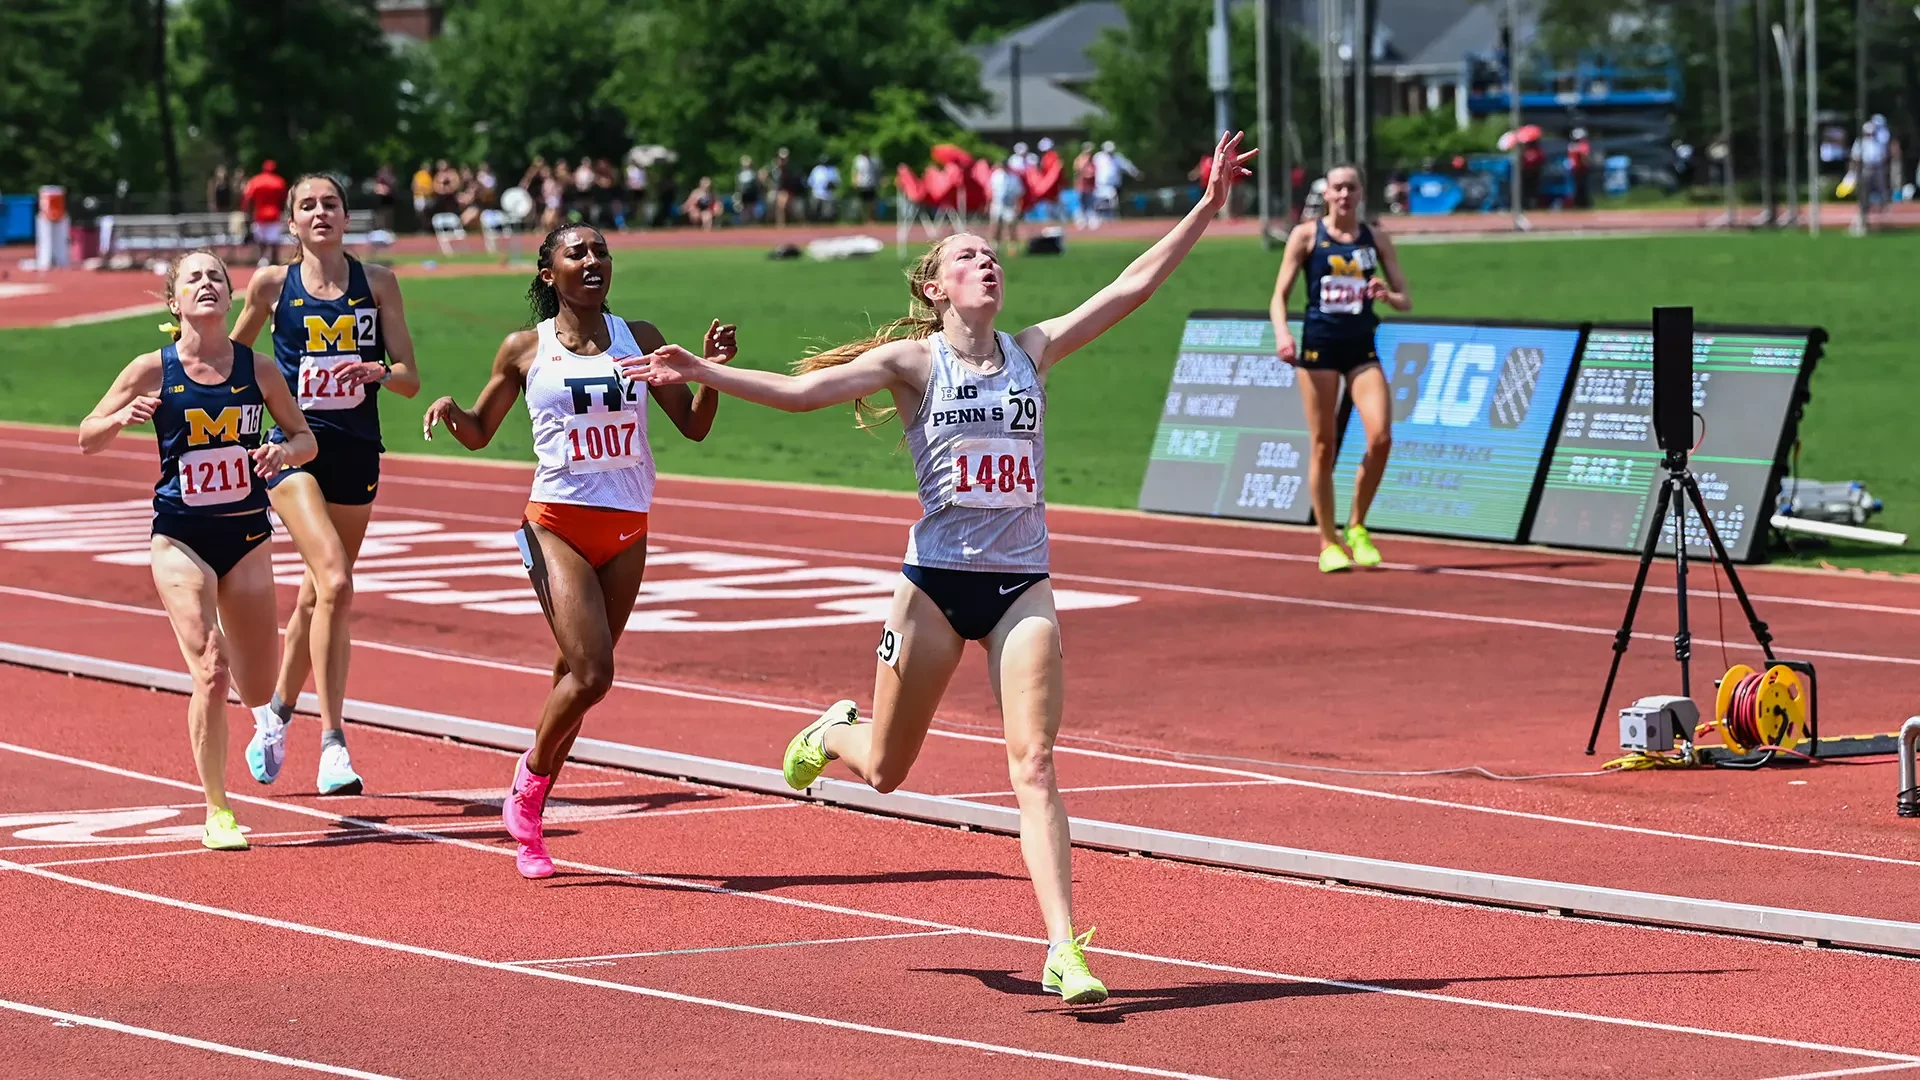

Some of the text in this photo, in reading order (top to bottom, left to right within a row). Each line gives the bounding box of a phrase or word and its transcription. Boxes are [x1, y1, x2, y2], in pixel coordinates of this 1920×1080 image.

[303, 315, 357, 352] M
[359, 315, 374, 341] 2
[185, 406, 242, 446] M
[932, 407, 986, 428] PENN
[1008, 397, 1038, 431] 29
[568, 422, 637, 462] 1007
[183, 457, 248, 495] 1211
[955, 454, 1036, 493] 1484
